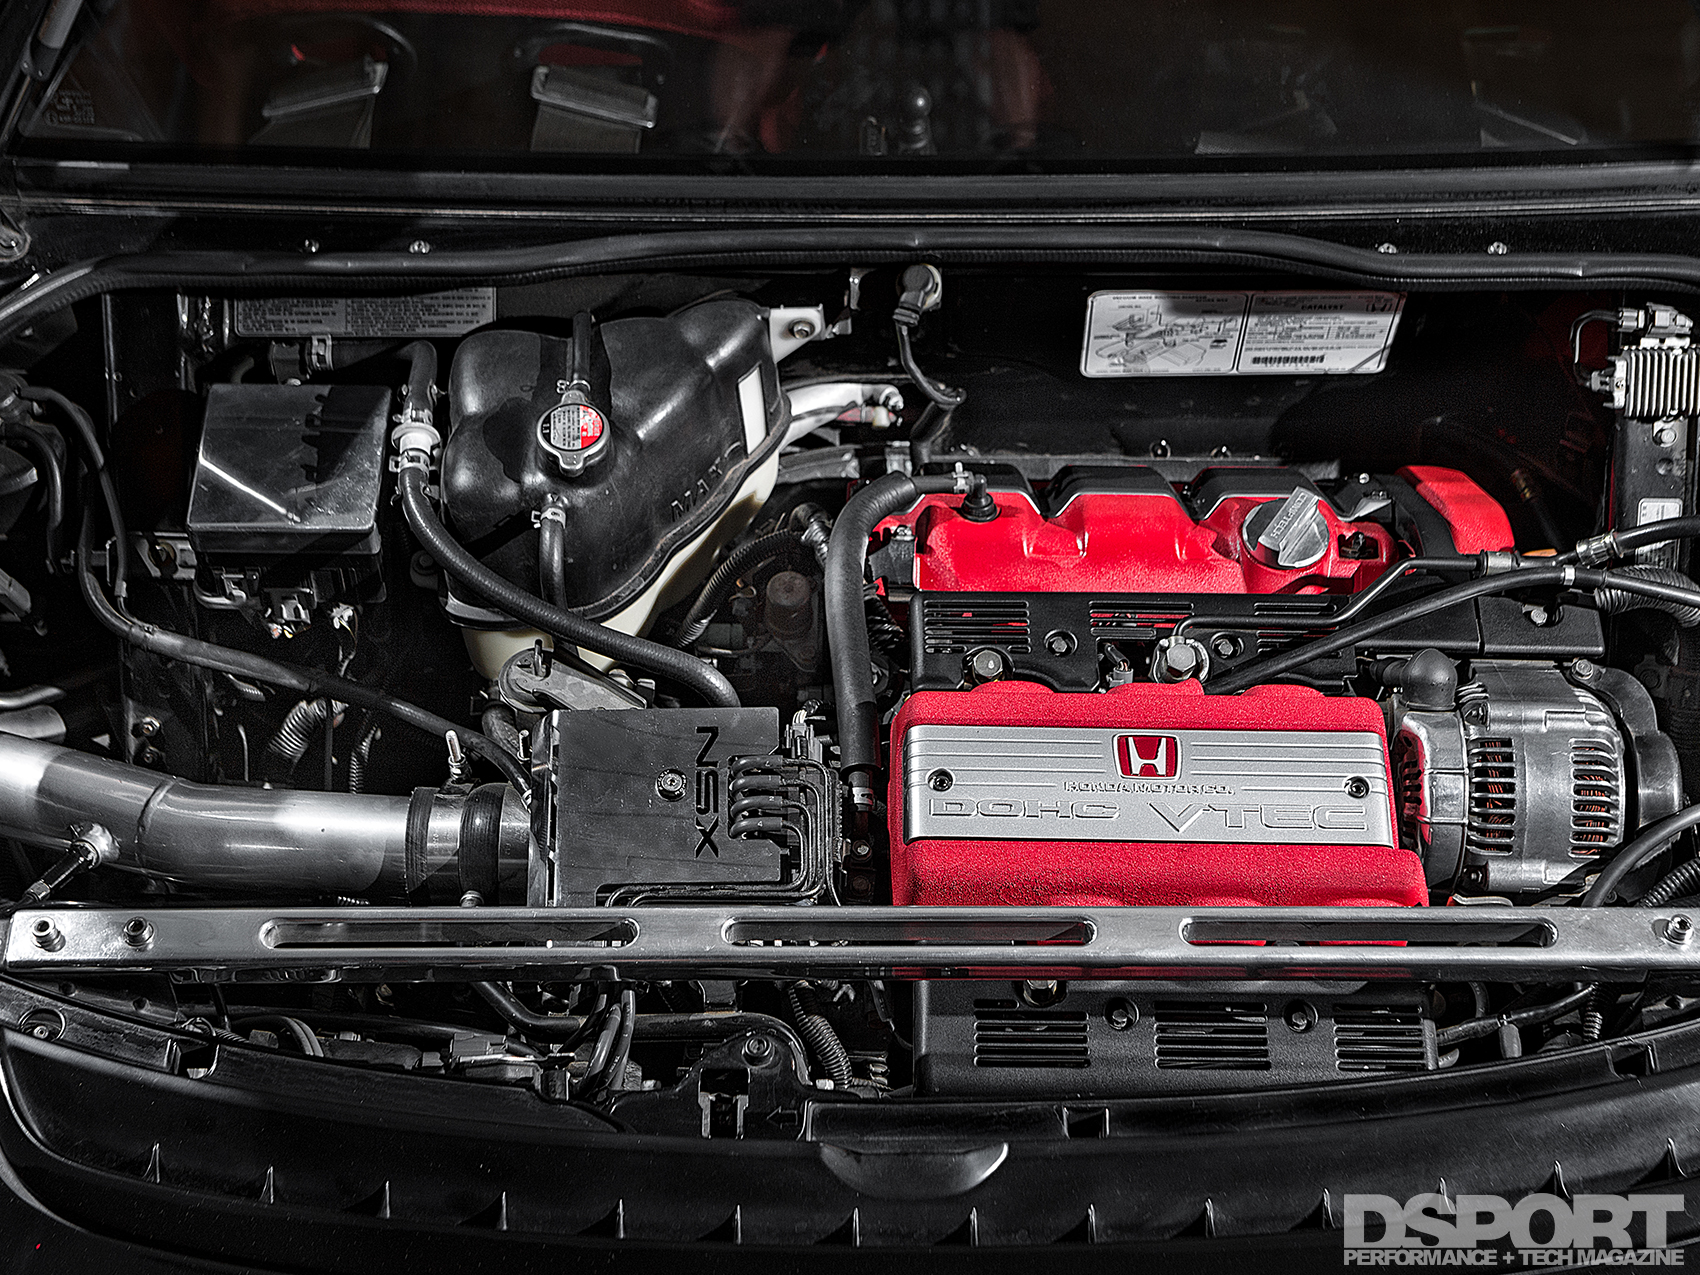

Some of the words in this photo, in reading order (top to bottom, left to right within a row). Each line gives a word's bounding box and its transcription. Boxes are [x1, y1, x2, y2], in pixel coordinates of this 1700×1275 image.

[695, 726, 719, 858] NSX
[1063, 781, 1131, 793] HONDA
[1132, 782, 1203, 794] MOTOR
[929, 798, 1121, 820] DOHC
[1147, 801, 1369, 832] VTEC
